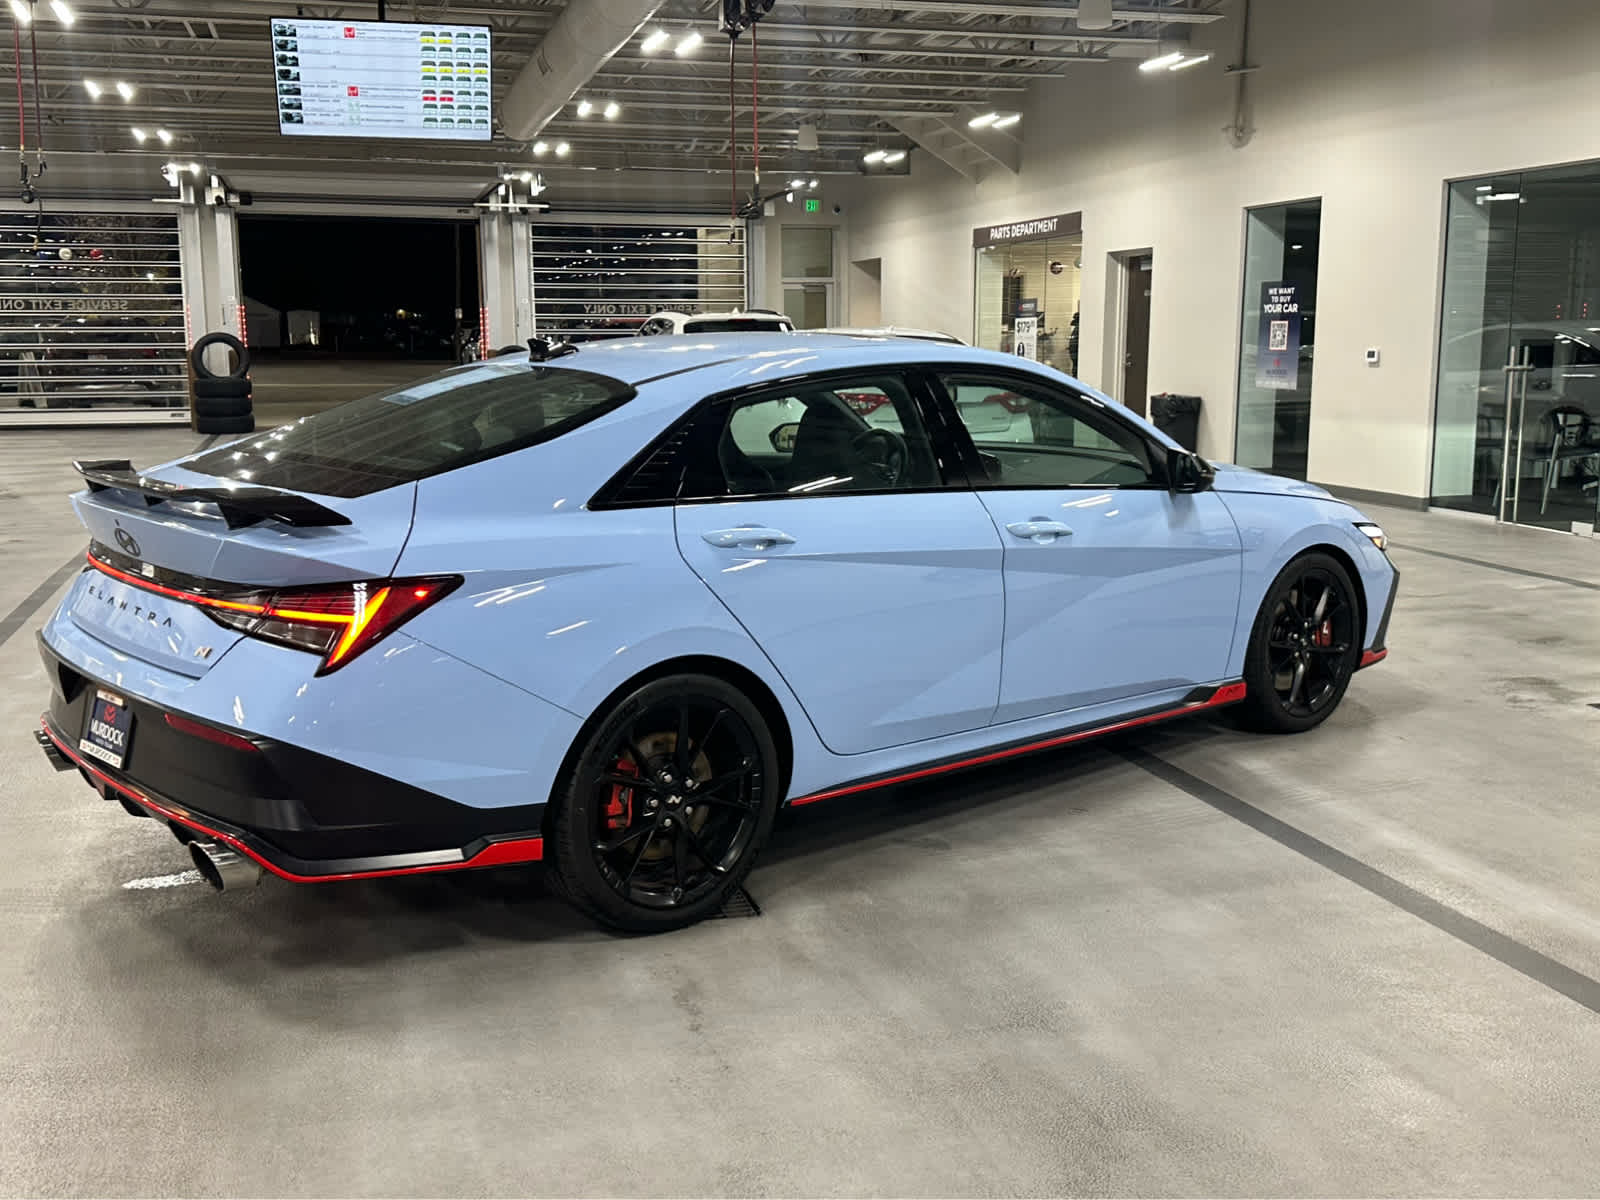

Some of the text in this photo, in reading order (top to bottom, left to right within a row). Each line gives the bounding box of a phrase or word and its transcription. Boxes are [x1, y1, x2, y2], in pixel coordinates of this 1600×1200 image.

[990, 218, 1058, 241] PARTS DEPARTMENT
[1279, 287, 1295, 295] WANT
[1280, 295, 1291, 303] BUY
[1263, 303, 1299, 313] YOUR CAR
[88, 585, 173, 628] ELANTRA
[194, 646, 212, 659] N
[90, 718, 124, 746] MURDOCK
